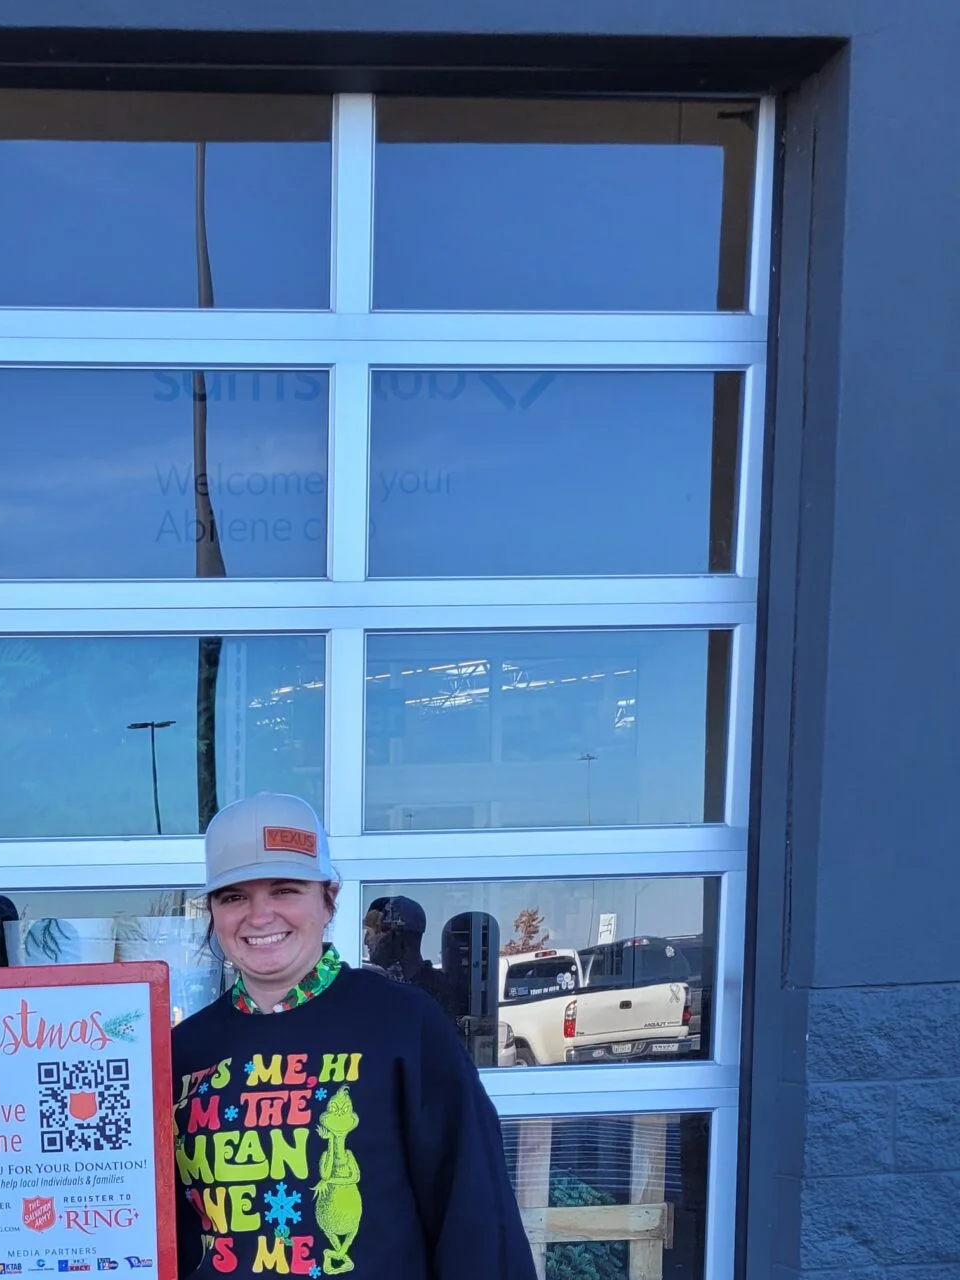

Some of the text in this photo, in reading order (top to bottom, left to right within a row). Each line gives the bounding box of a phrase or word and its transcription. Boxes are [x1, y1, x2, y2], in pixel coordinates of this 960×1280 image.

[154, 461, 458, 502] Welcome your
[154, 508, 292, 543] Abilene
[268, 830, 315, 848] VEXUS
[318, 1053, 362, 1082] HI
[240, 1090, 312, 1127] THE
[175, 1128, 309, 1185] MEAN
[0, 1177, 18, 1190] help
[19, 1176, 39, 1188] local
[40, 1175, 84, 1187] Individuals
[92, 1174, 124, 1187] families
[28, 1199, 41, 1212] THE
[63, 1194, 114, 1203] REGISTER
[24, 1199, 53, 1225] SALVATION
[34, 1211, 52, 1229] ARMY
[7, 1247, 97, 1258] MEDIA PARTNERS
[252, 1235, 315, 1274] ME
[6, 1263, 22, 1271] KTAB
